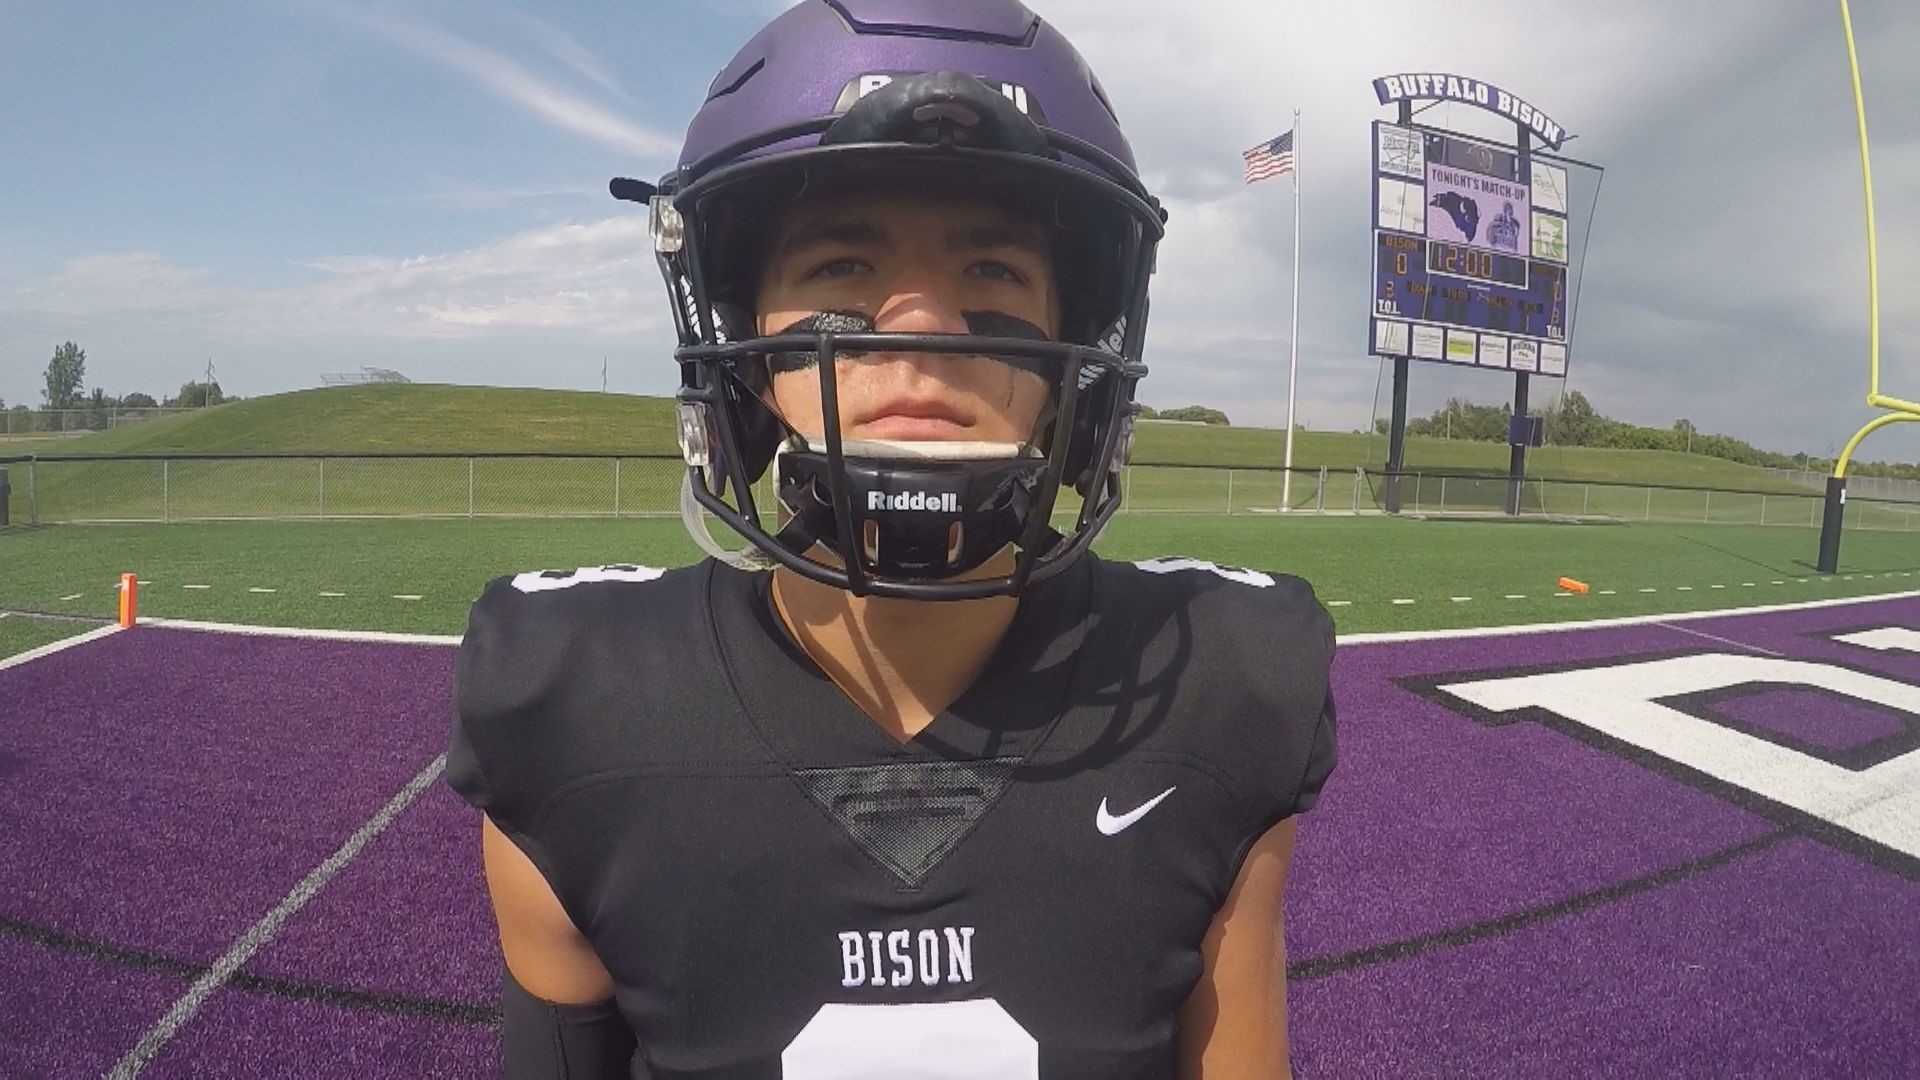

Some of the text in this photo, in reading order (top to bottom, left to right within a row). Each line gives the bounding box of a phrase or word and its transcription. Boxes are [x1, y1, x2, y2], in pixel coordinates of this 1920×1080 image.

[1384, 74, 1561, 144] BUFFALO BISON
[1432, 168, 1479, 190] TONIGHT'S
[1481, 179, 1525, 202] MATCH-UP
[1386, 235, 1418, 251] BISON
[1396, 252, 1407, 275] 0
[1437, 245, 1493, 278] 12:00
[867, 490, 957, 512] Riddell
[838, 927, 975, 987] BISON
